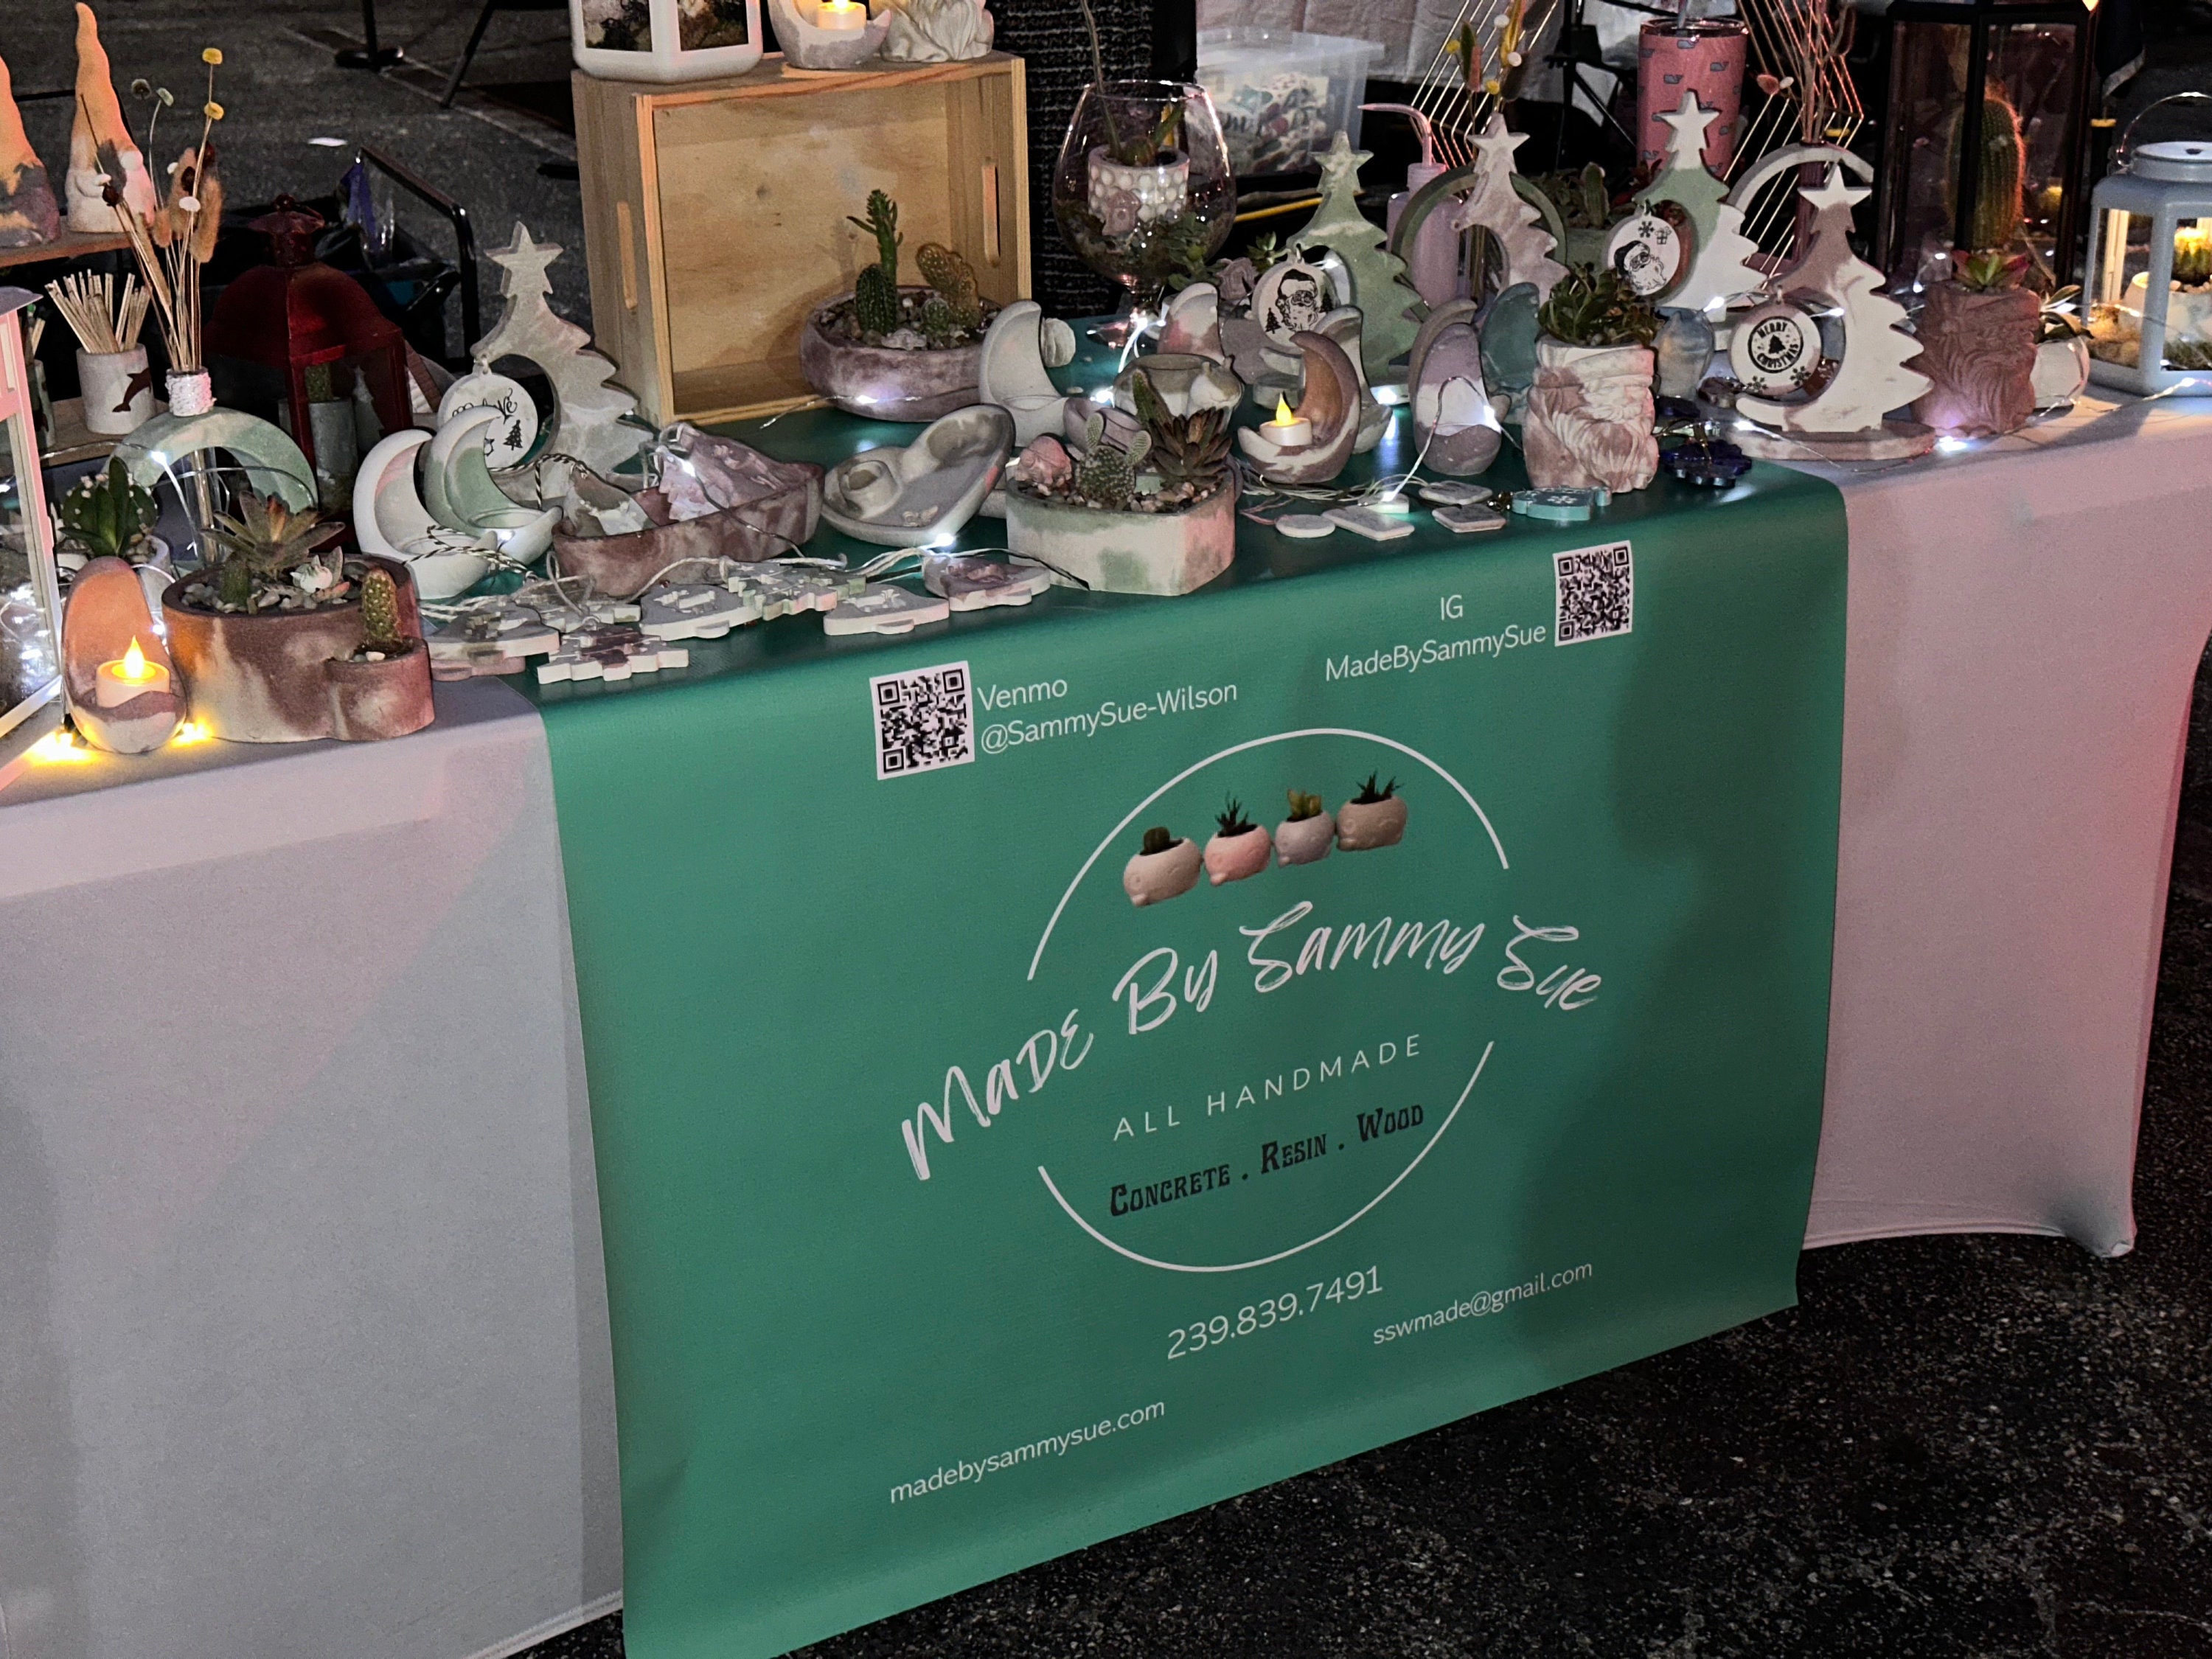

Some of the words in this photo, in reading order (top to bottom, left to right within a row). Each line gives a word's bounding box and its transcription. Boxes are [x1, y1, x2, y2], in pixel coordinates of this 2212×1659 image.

[1756, 321, 1787, 338] MERRY
[1756, 343, 1799, 369] CHRISTMAS
[1440, 594, 1464, 621] IG
[1326, 625, 1547, 681] MadeBySammySue
[977, 679, 1068, 711] Venmo
[981, 684, 1237, 754] @SammySue-Wilson
[1112, 947, 1218, 1035] By
[1239, 900, 1486, 993] Sammy
[1497, 914, 1601, 1011] Sue
[1113, 1105, 1180, 1141] ALL
[1207, 1034, 1421, 1116] HANDMADE
[1167, 1265, 1383, 1360] 239.839.7491
[1373, 1262, 1593, 1345] sswmade@gmail.com
[890, 1402, 1165, 1503] madebysammysue.com
